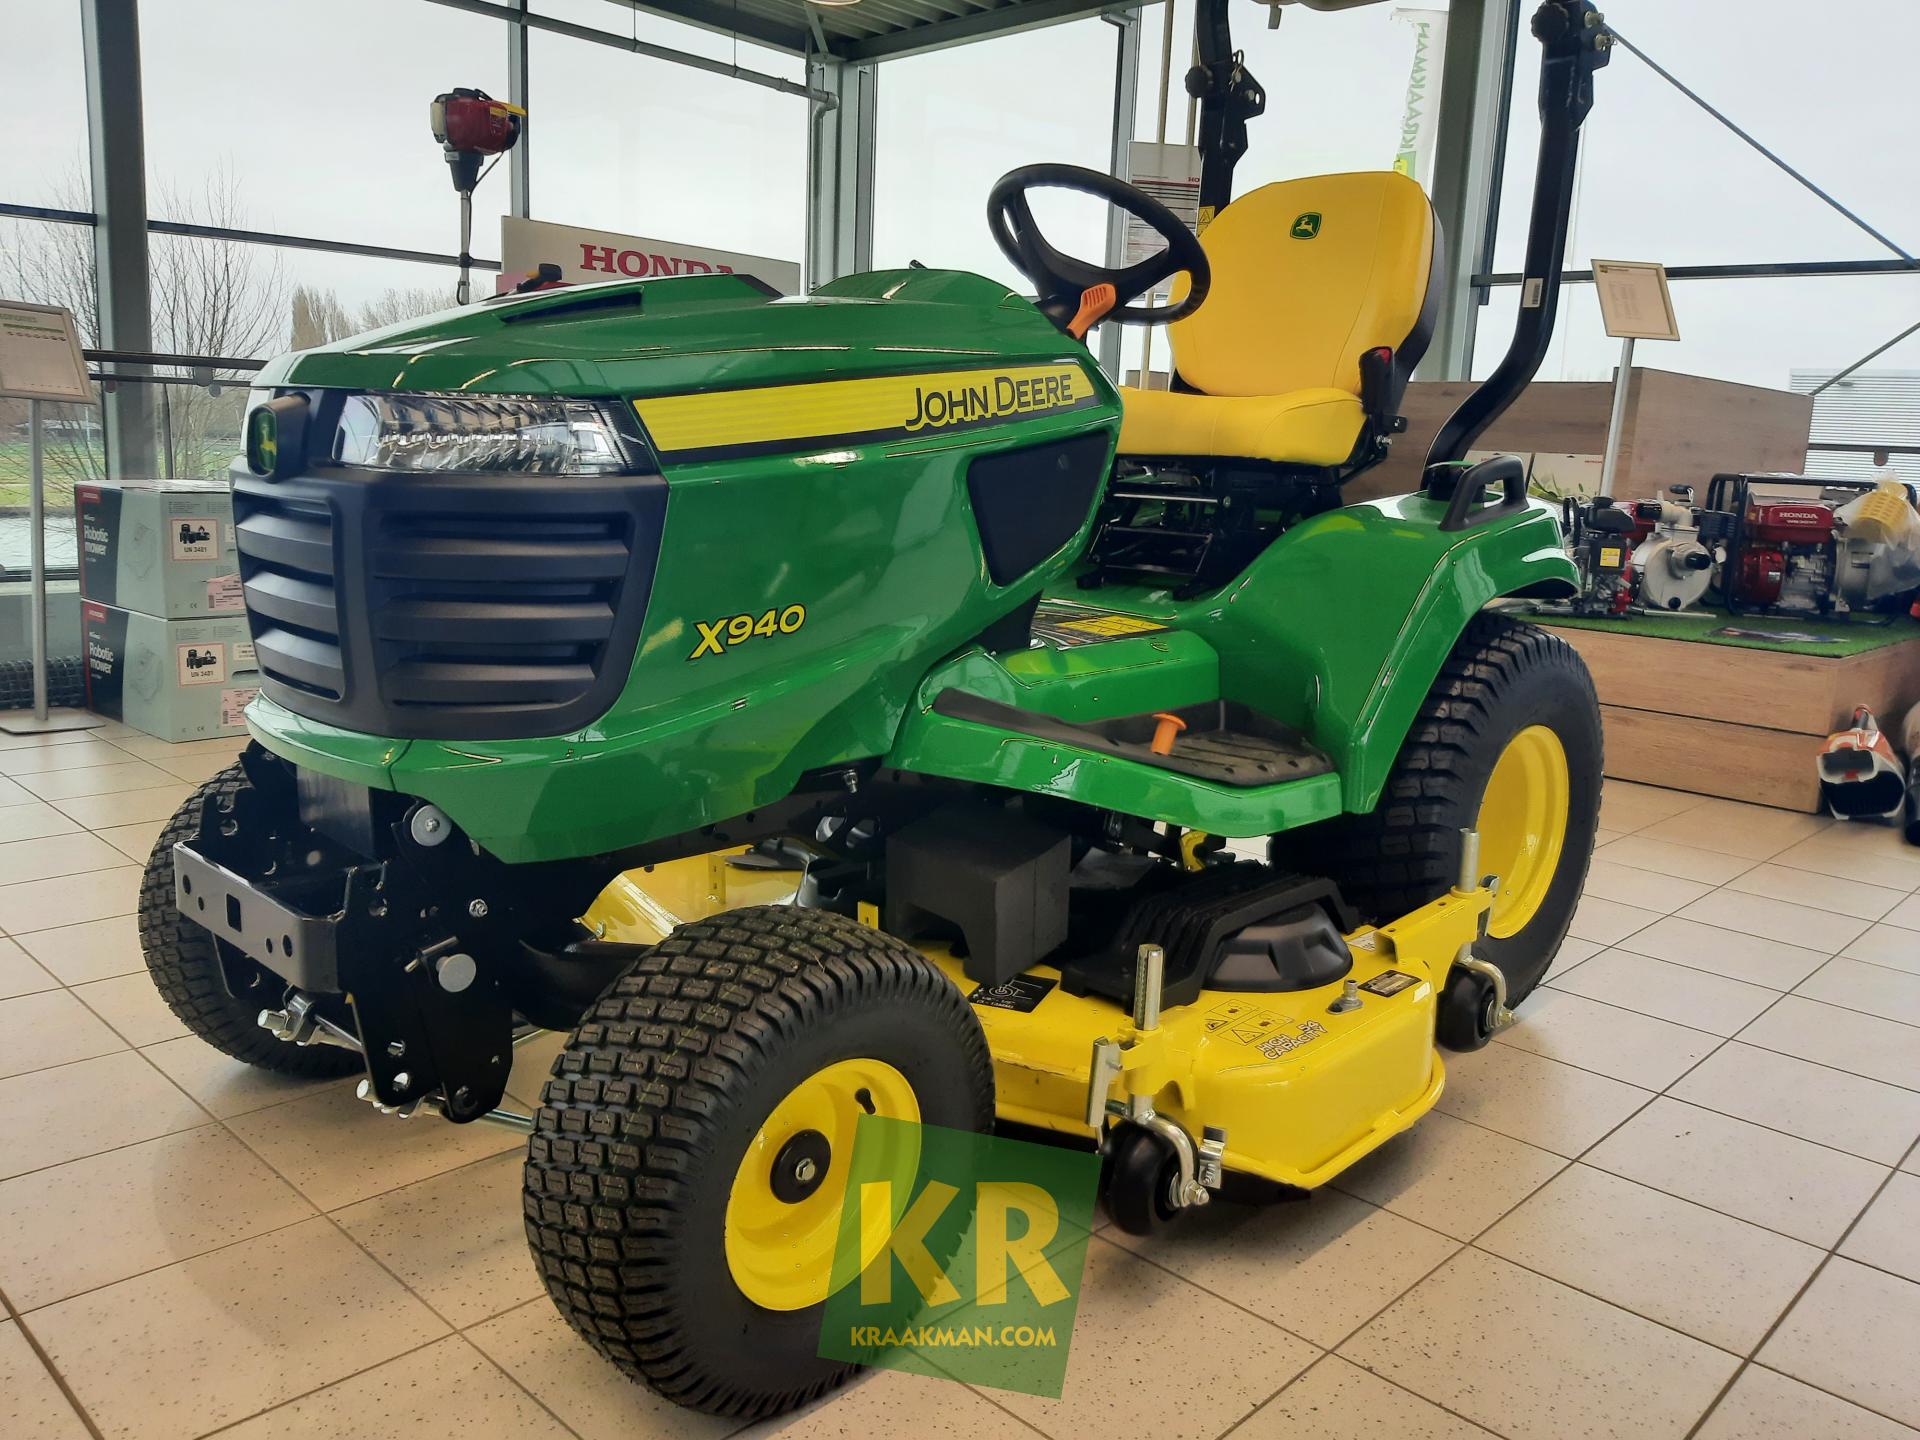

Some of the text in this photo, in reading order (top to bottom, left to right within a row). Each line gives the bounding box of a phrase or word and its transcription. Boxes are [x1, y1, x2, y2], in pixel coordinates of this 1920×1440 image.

[905, 374, 1073, 427] JOHN DEERE
[83, 525, 109, 543] Robotic
[84, 541, 107, 556] mower
[686, 603, 806, 660] X940
[89, 642, 114, 662] Robotic
[89, 658, 112, 675] mower
[1255, 1033, 1291, 1052] HIGH
[1263, 1023, 1328, 1060] CAPACITY
